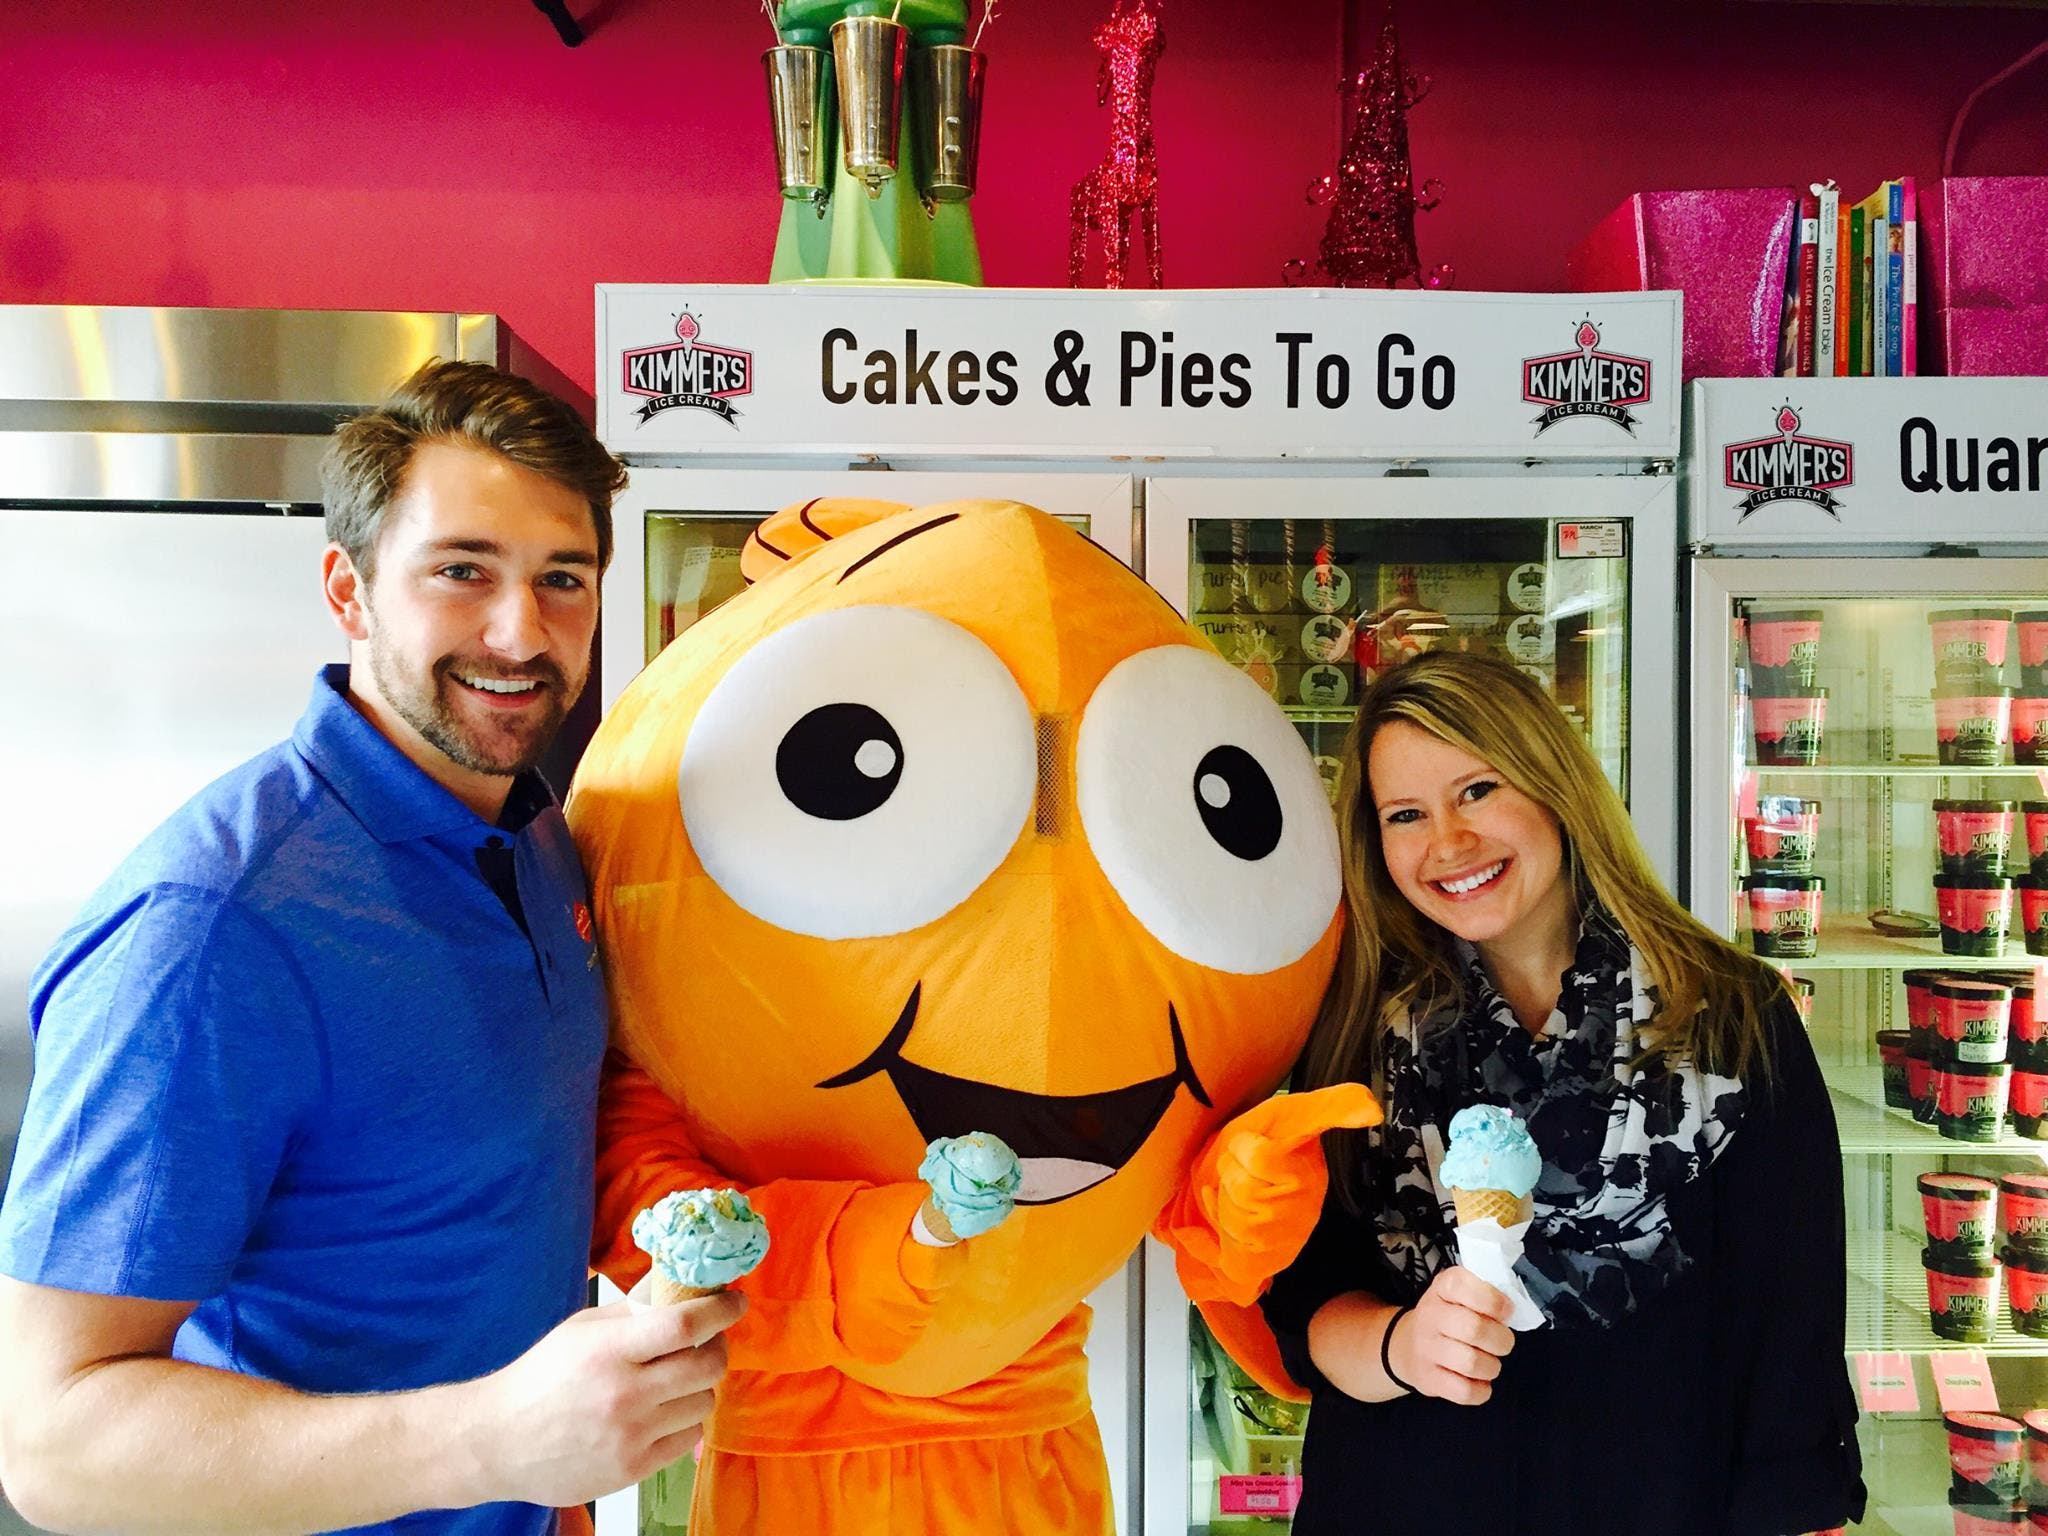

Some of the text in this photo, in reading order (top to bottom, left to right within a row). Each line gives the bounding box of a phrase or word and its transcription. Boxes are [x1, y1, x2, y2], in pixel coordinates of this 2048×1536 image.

[1825, 248, 1834, 263] the
[1823, 265, 1835, 283] Ice
[1821, 284, 1834, 325] Cream
[1820, 328, 1833, 355] bible
[630, 353, 746, 394] KIMMER'S
[821, 328, 1456, 411] Cakes & Pies To Go
[1529, 356, 1643, 402] KIMMER'S
[654, 394, 722, 411] ICE CREAM
[1553, 403, 1620, 418] ICE CREAM
[1900, 416, 2048, 493] Quar
[1731, 444, 1846, 488] KIMMER'S
[1756, 487, 1823, 502] ICE CREAM
[1959, 719, 1998, 735] KIMMER
[1773, 909, 1815, 927] KIMMER
[1947, 1295, 1990, 1313] KIMMER
